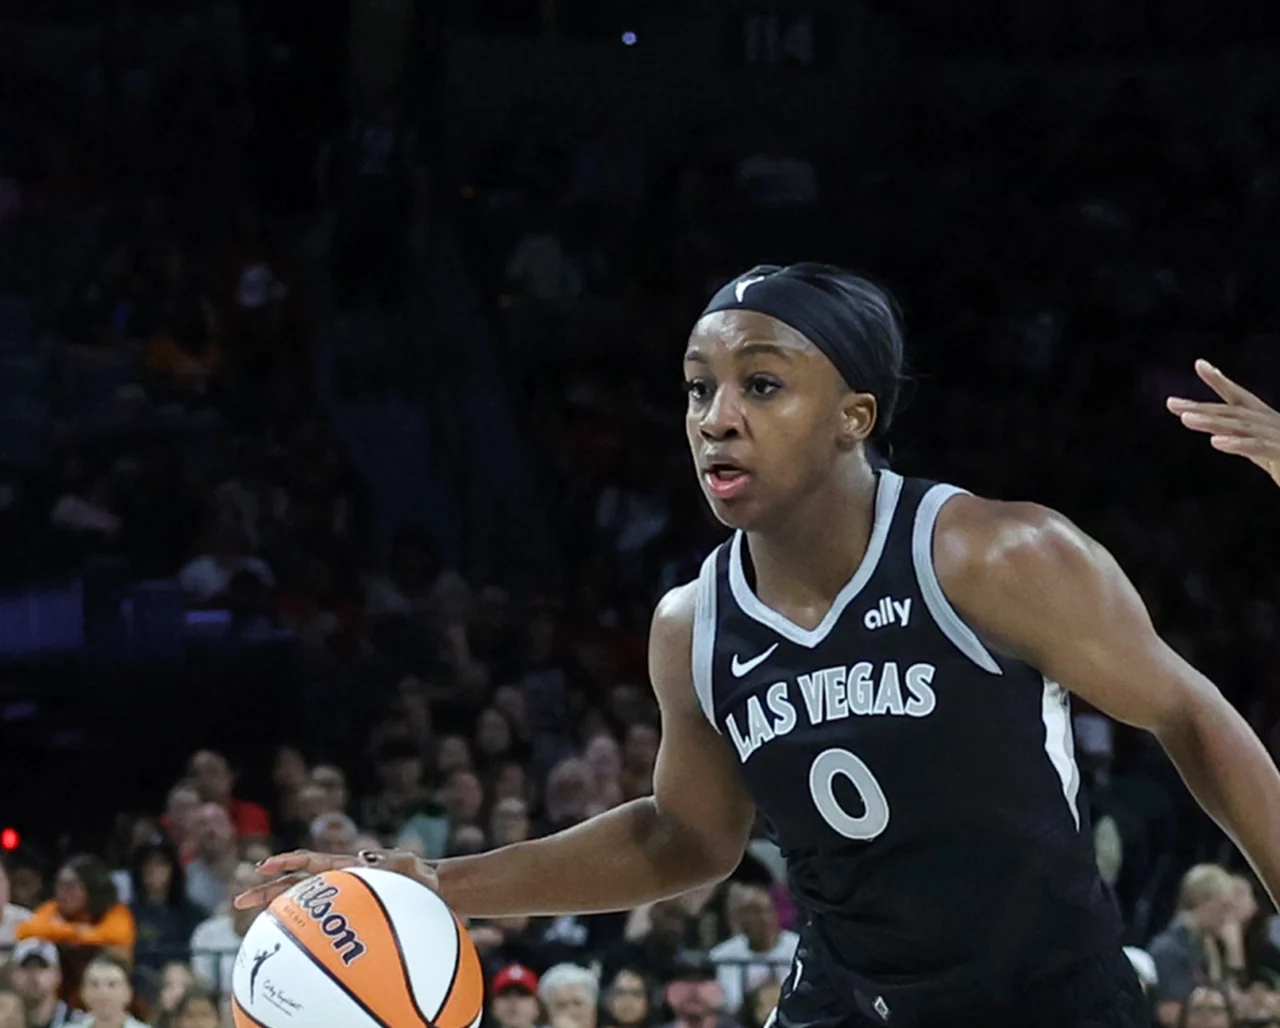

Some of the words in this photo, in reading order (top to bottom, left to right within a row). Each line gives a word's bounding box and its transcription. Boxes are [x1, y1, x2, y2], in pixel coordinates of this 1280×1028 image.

[864, 597, 912, 630] ally
[725, 681, 797, 763] LAS
[797, 662, 936, 725] VEGAS
[809, 748, 890, 840] 0
